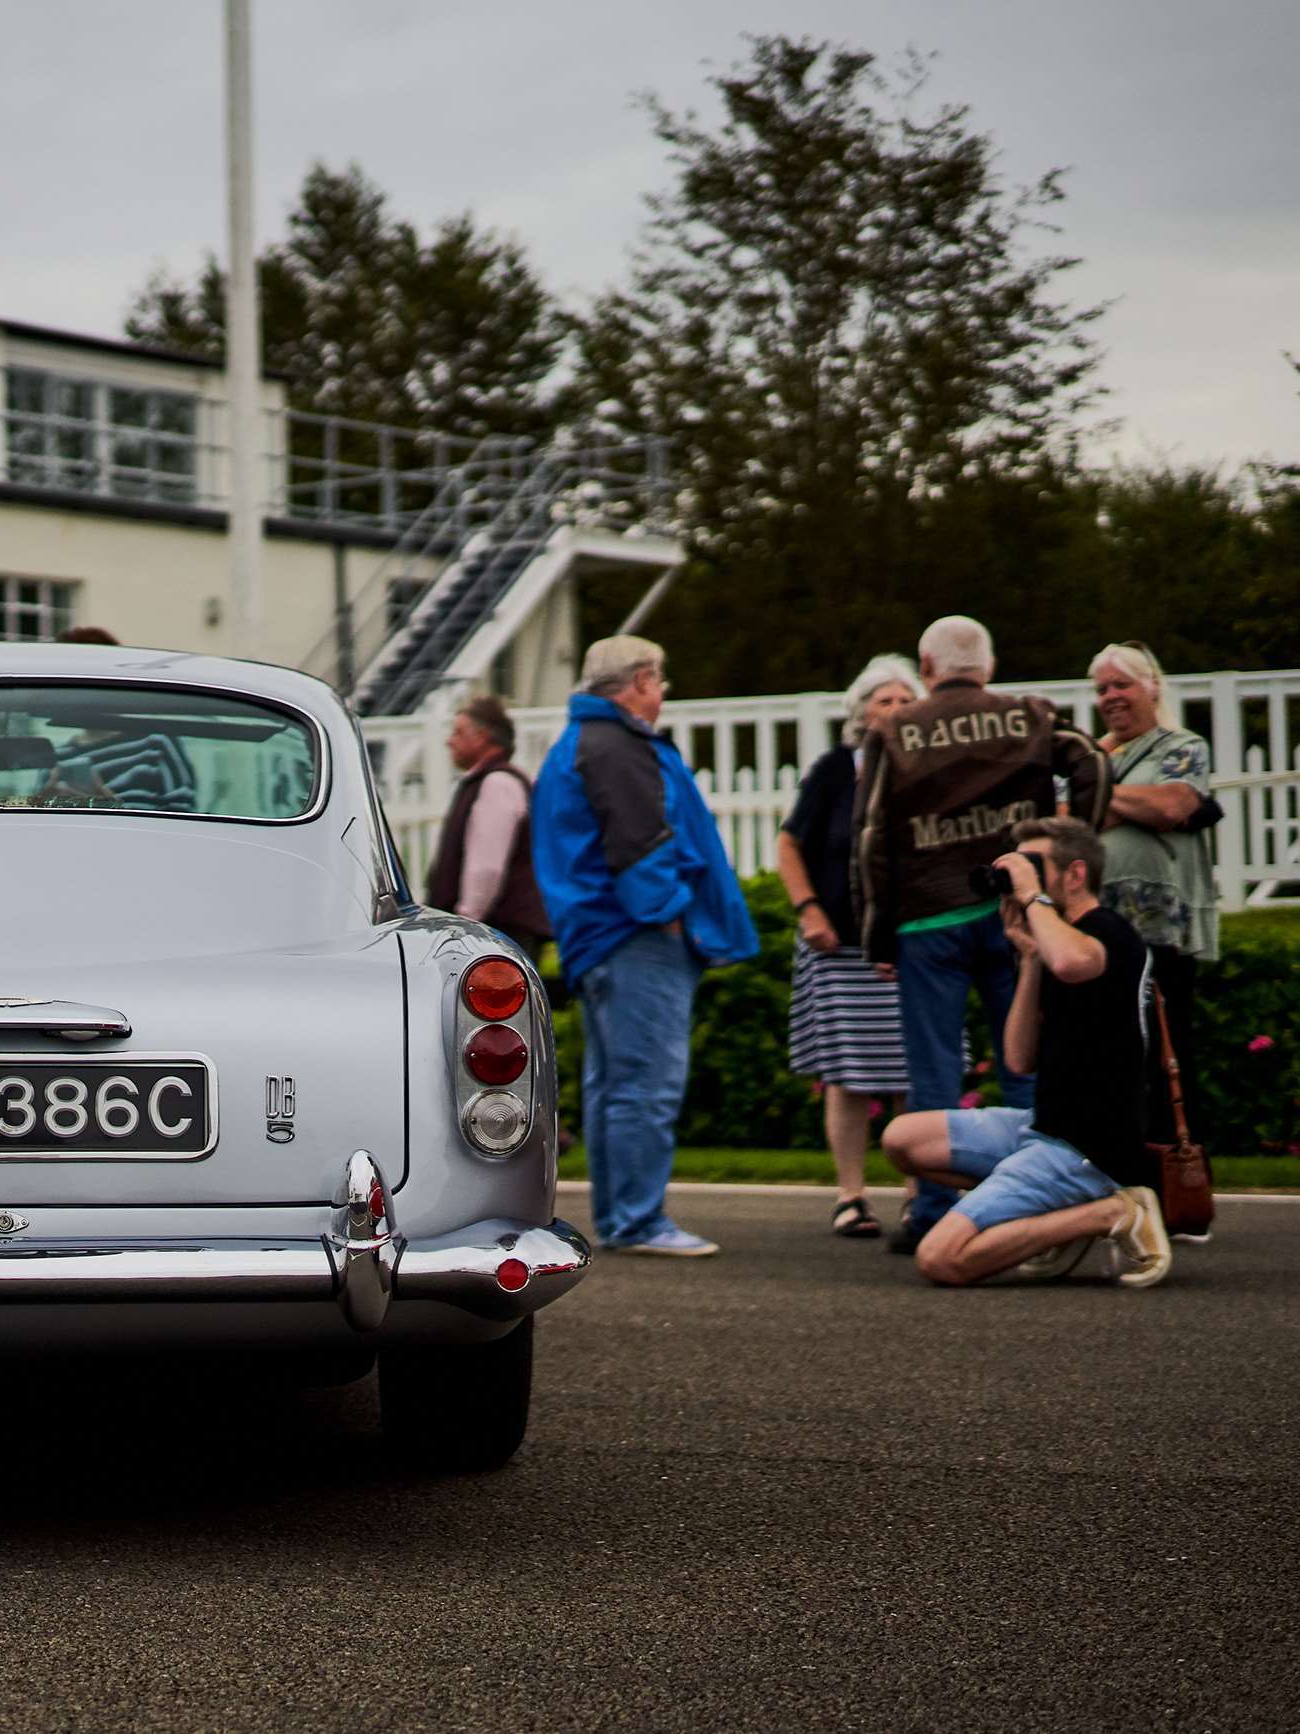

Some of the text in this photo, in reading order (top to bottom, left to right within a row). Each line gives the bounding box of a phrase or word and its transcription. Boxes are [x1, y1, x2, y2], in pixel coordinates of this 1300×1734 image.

[900, 708, 1029, 752] RACING
[266, 1075, 296, 1119] DB
[266, 1120, 296, 1144] 5
